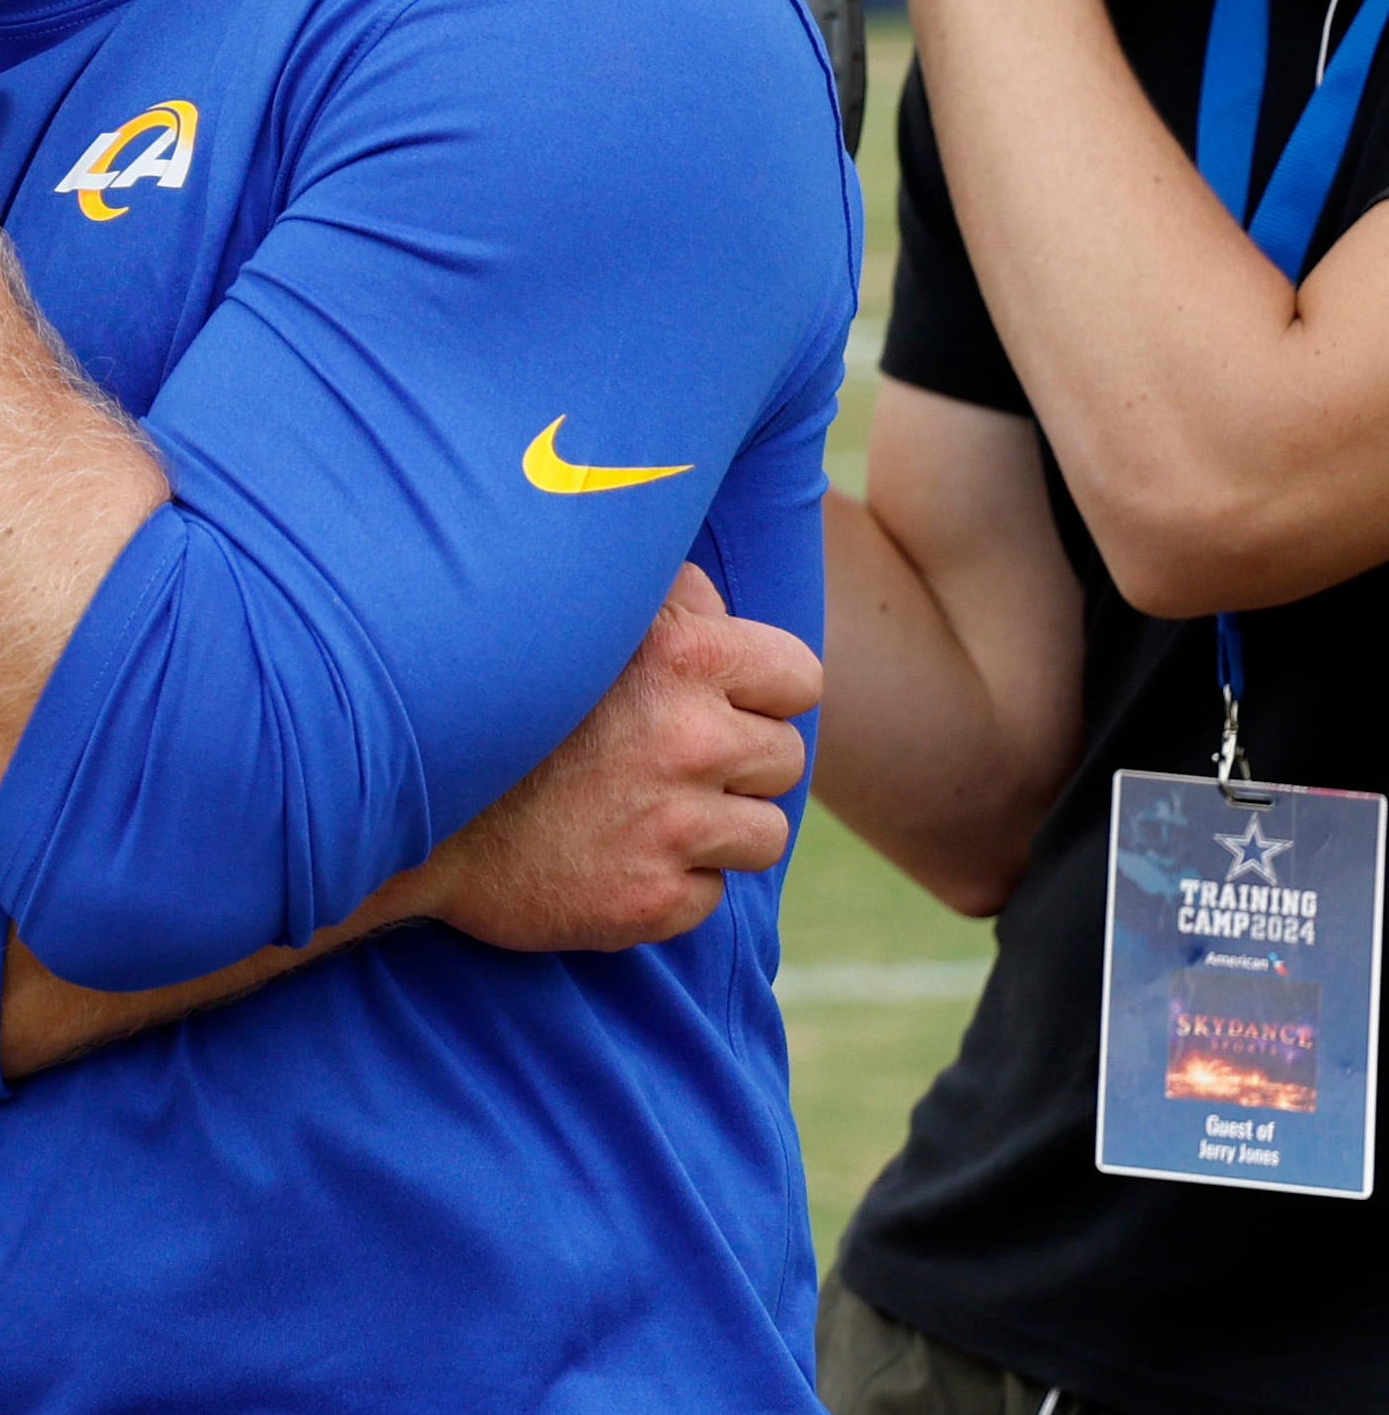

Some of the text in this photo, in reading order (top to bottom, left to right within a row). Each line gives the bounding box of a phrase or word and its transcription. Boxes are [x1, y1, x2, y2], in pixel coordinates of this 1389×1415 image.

[1179, 879, 1318, 918] TRAINING
[1204, 951, 1269, 971] American
[1176, 1013, 1314, 1049] SKYDANCE
[1205, 1114, 1275, 1142] Guest of
[1198, 1140, 1281, 1167] Jerry Jones
